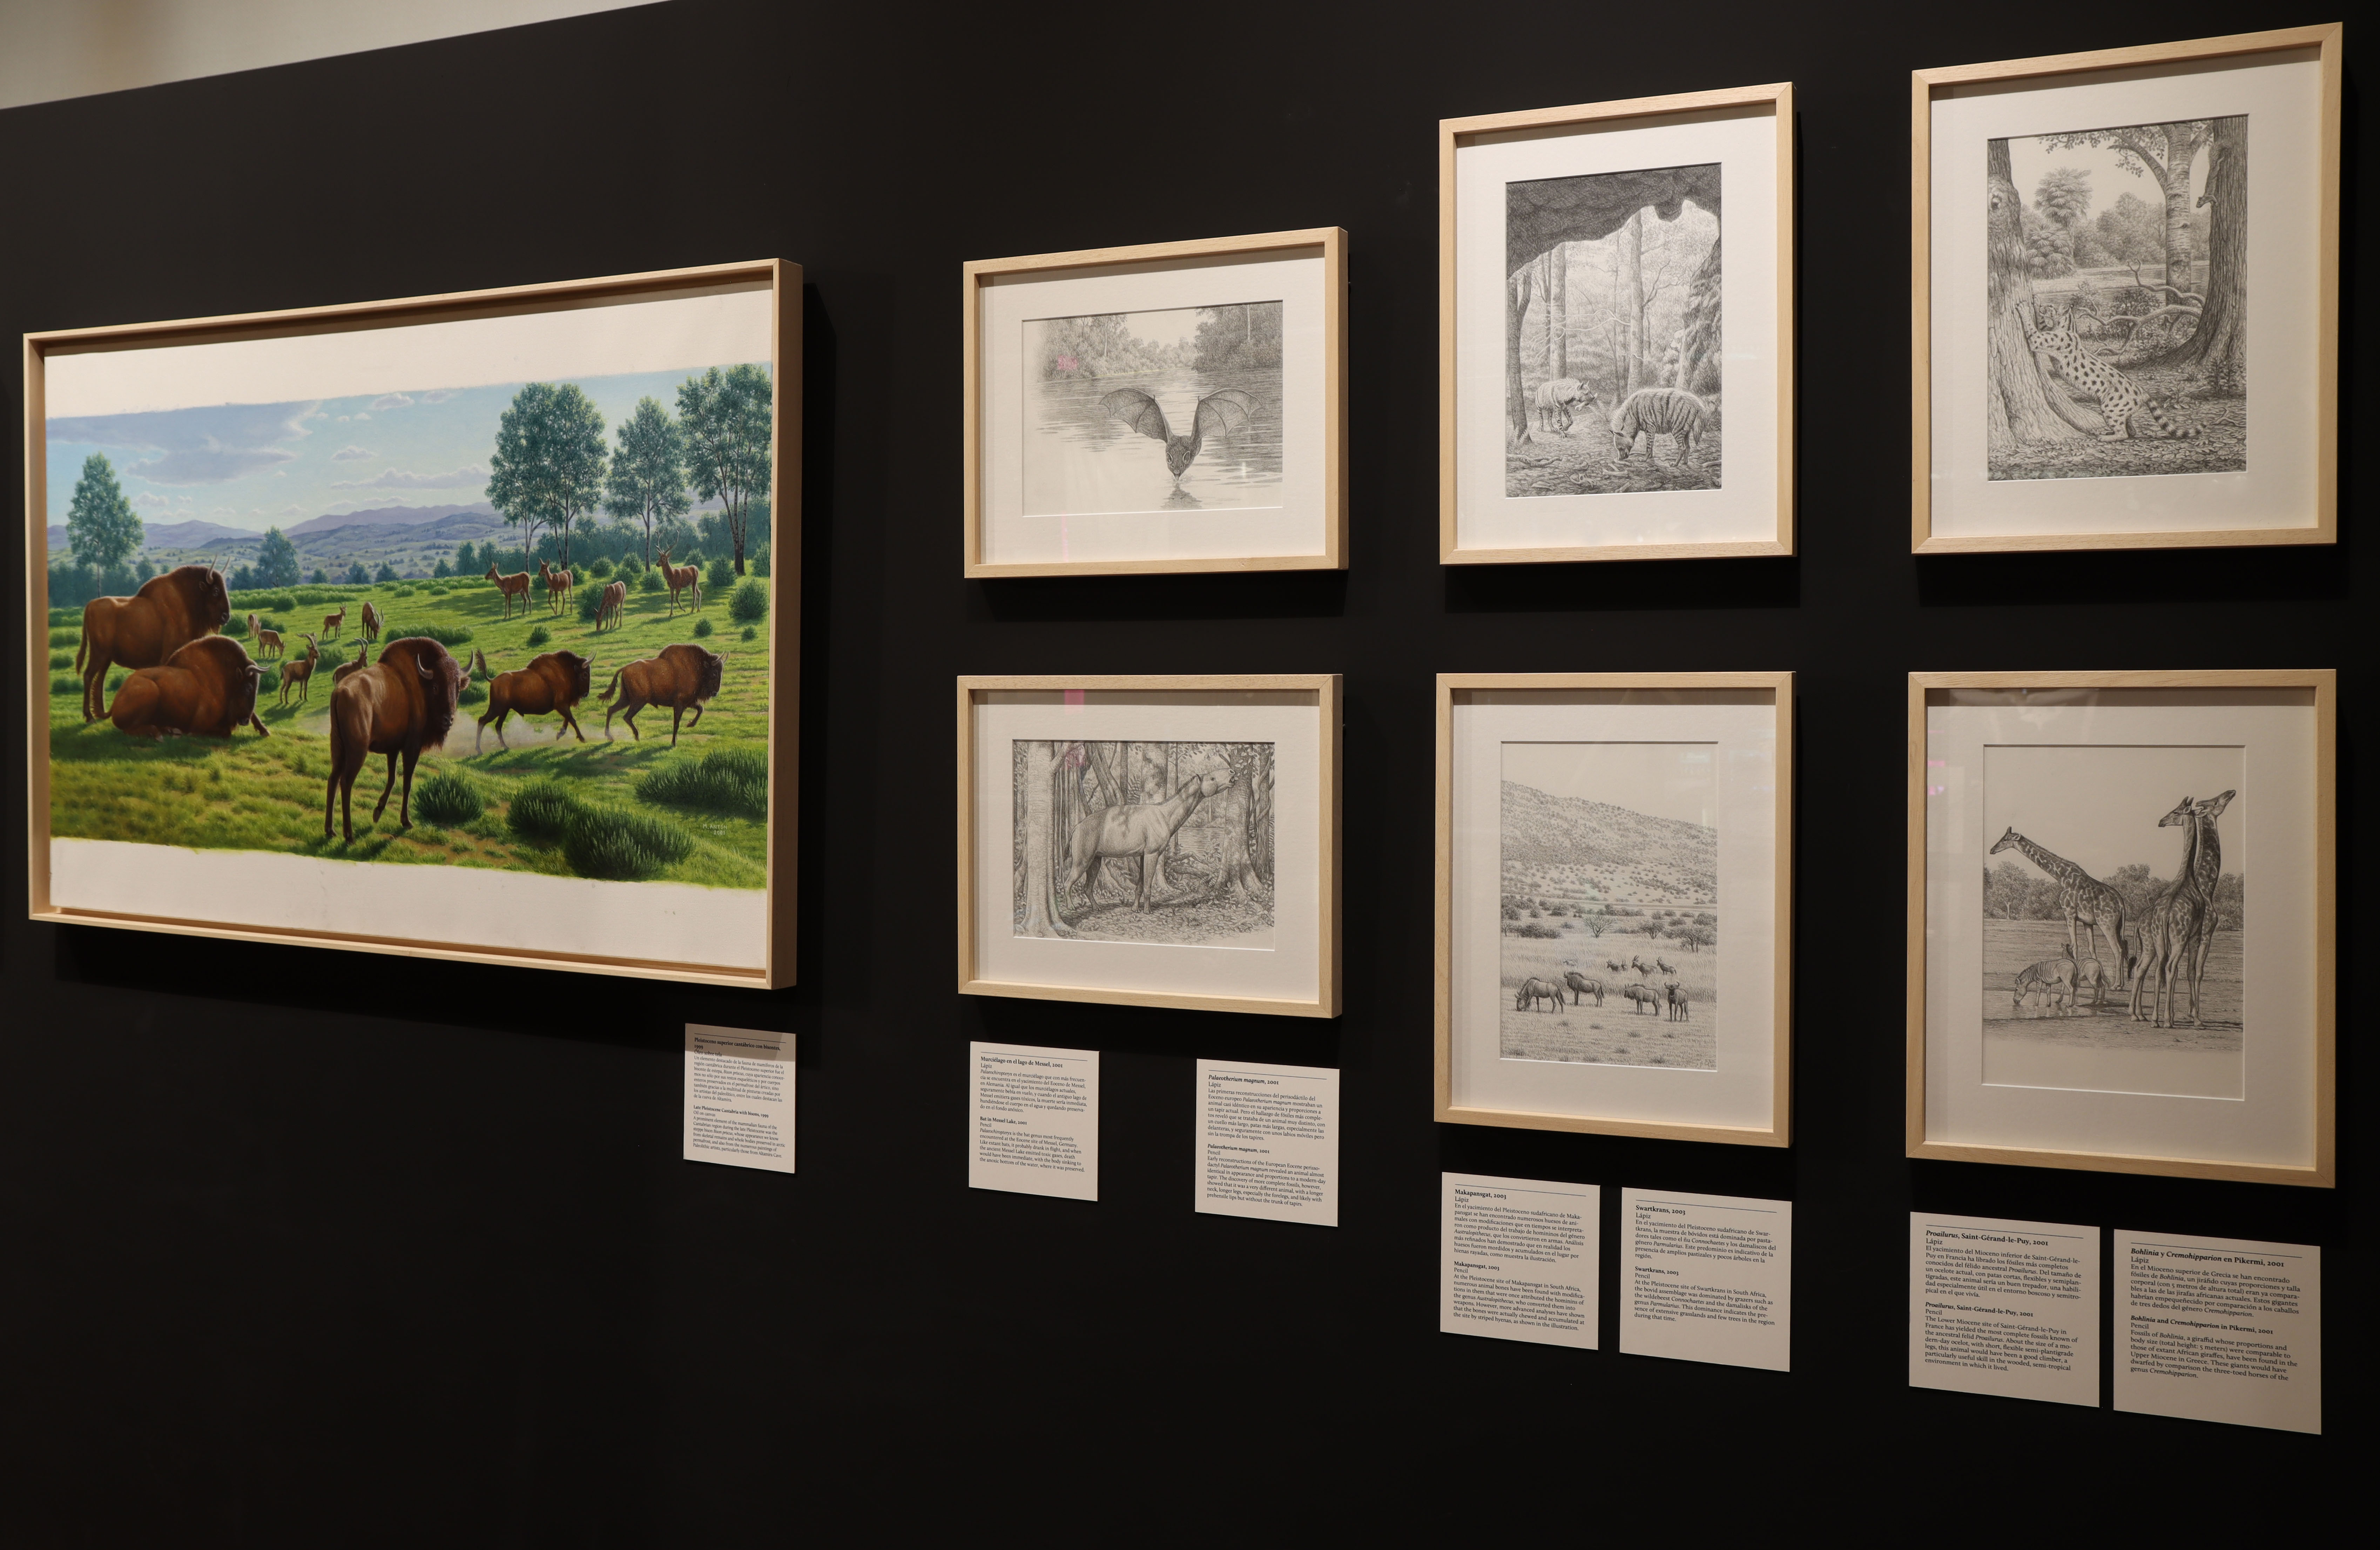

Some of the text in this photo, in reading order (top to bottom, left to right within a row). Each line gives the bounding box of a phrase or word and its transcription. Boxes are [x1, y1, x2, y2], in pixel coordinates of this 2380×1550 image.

[980, 1069, 1012, 1077] Palaeochiropteryx
[980, 1128, 1012, 1136] Palaeochiropteryx
[1455, 1189, 1492, 1198] Makapansgat,
[1636, 1205, 1671, 1214] Swartkrans,
[1926, 1230, 1960, 1239] Proailurus,
[1961, 1233, 2031, 1246] Saint-Gérand-le-Puy,
[1926, 1238, 1943, 1246] Lápiz
[2031, 1254, 2080, 1264] Saint-Gérand-le-
[2131, 1248, 2159, 1256] Bohlinia
[2166, 1251, 2222, 1262] Cremohipparion
[2234, 1257, 2265, 1267] Pikermi,
[2131, 1256, 2149, 1264] Lápiz
[1454, 1261, 1487, 1270] Makapansgat,
[2147, 1265, 2174, 1273] Mioceno
[1634, 1266, 1666, 1275] Swartkrans,
[1925, 1302, 1956, 1310] Proailurus,
[1956, 1305, 2018, 1316] Saint-Gérand-le-Puy,
[2000, 1323, 2059, 1335] Saint-Gérand-le-Puy
[2170, 1319, 2220, 1329] Cremohipparion
[2229, 1325, 2257, 1334] Pikermi,
[2159, 1332, 2185, 1341] Bohlinia,
[2236, 1341, 2274, 1349] proportions
